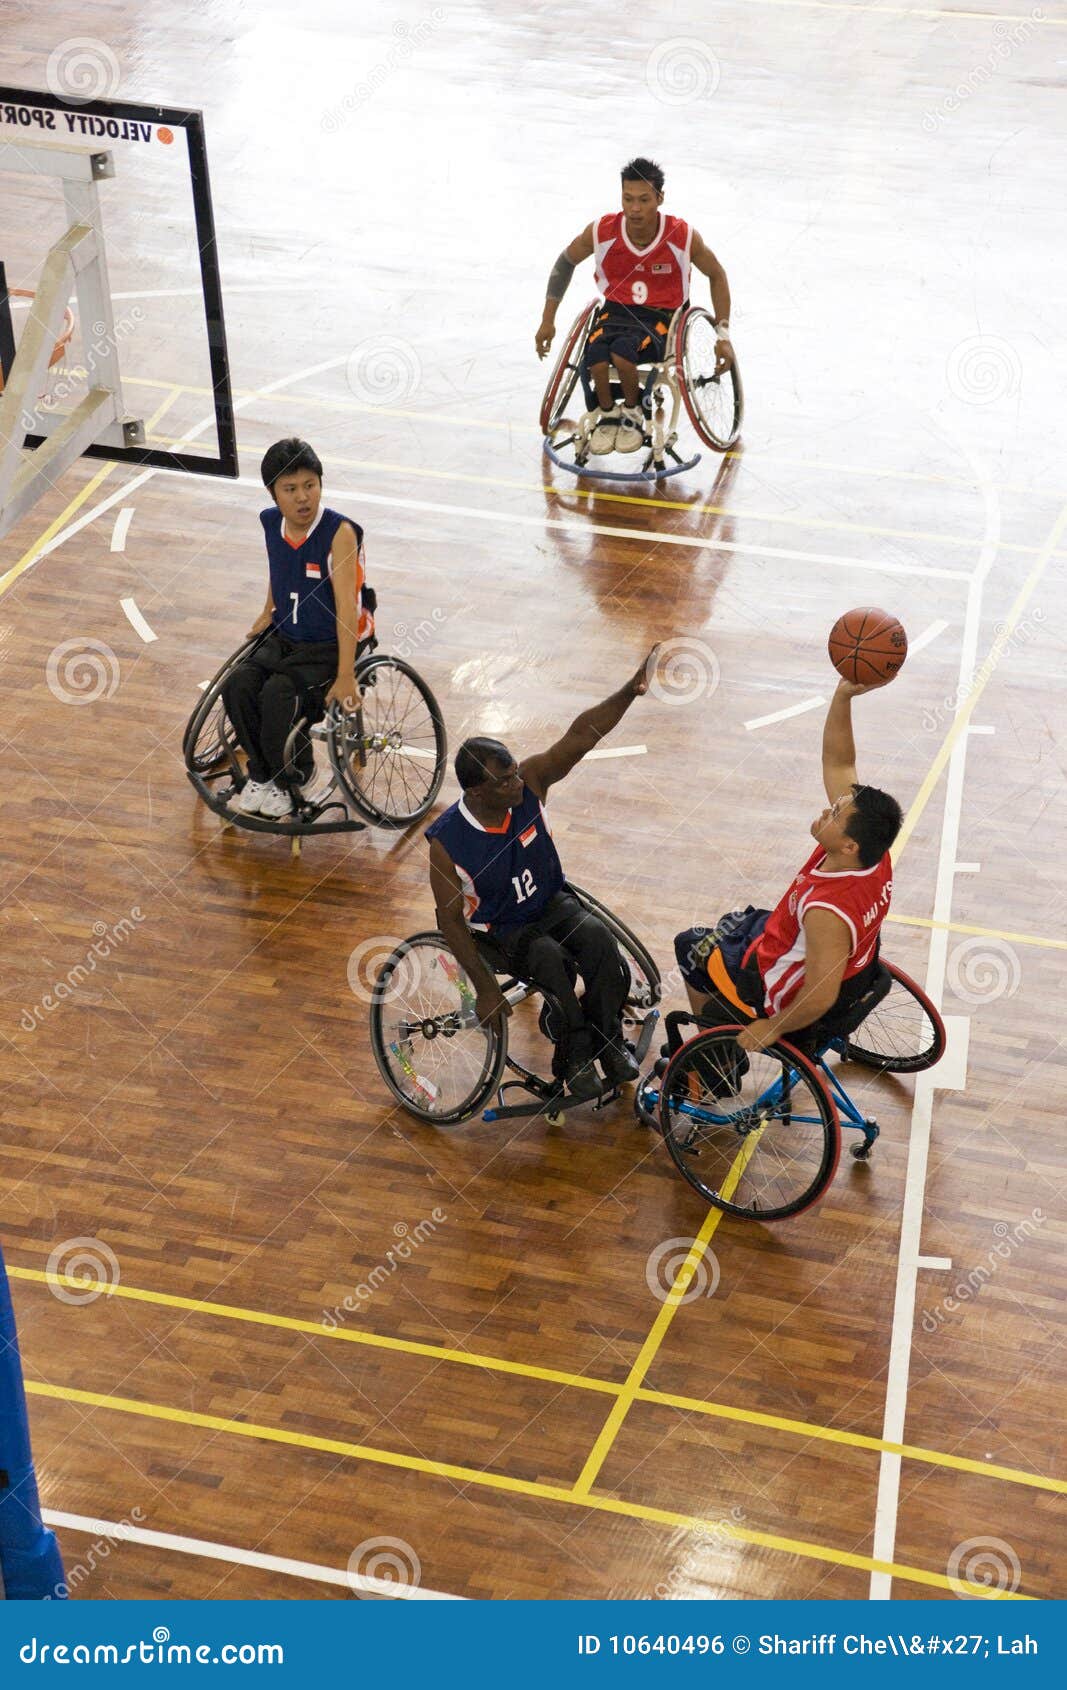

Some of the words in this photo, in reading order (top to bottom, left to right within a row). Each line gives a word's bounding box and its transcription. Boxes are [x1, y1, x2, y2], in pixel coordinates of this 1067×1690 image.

[631, 281, 649, 305] 9
[289, 592, 299, 624] 7
[511, 868, 538, 904] 12
